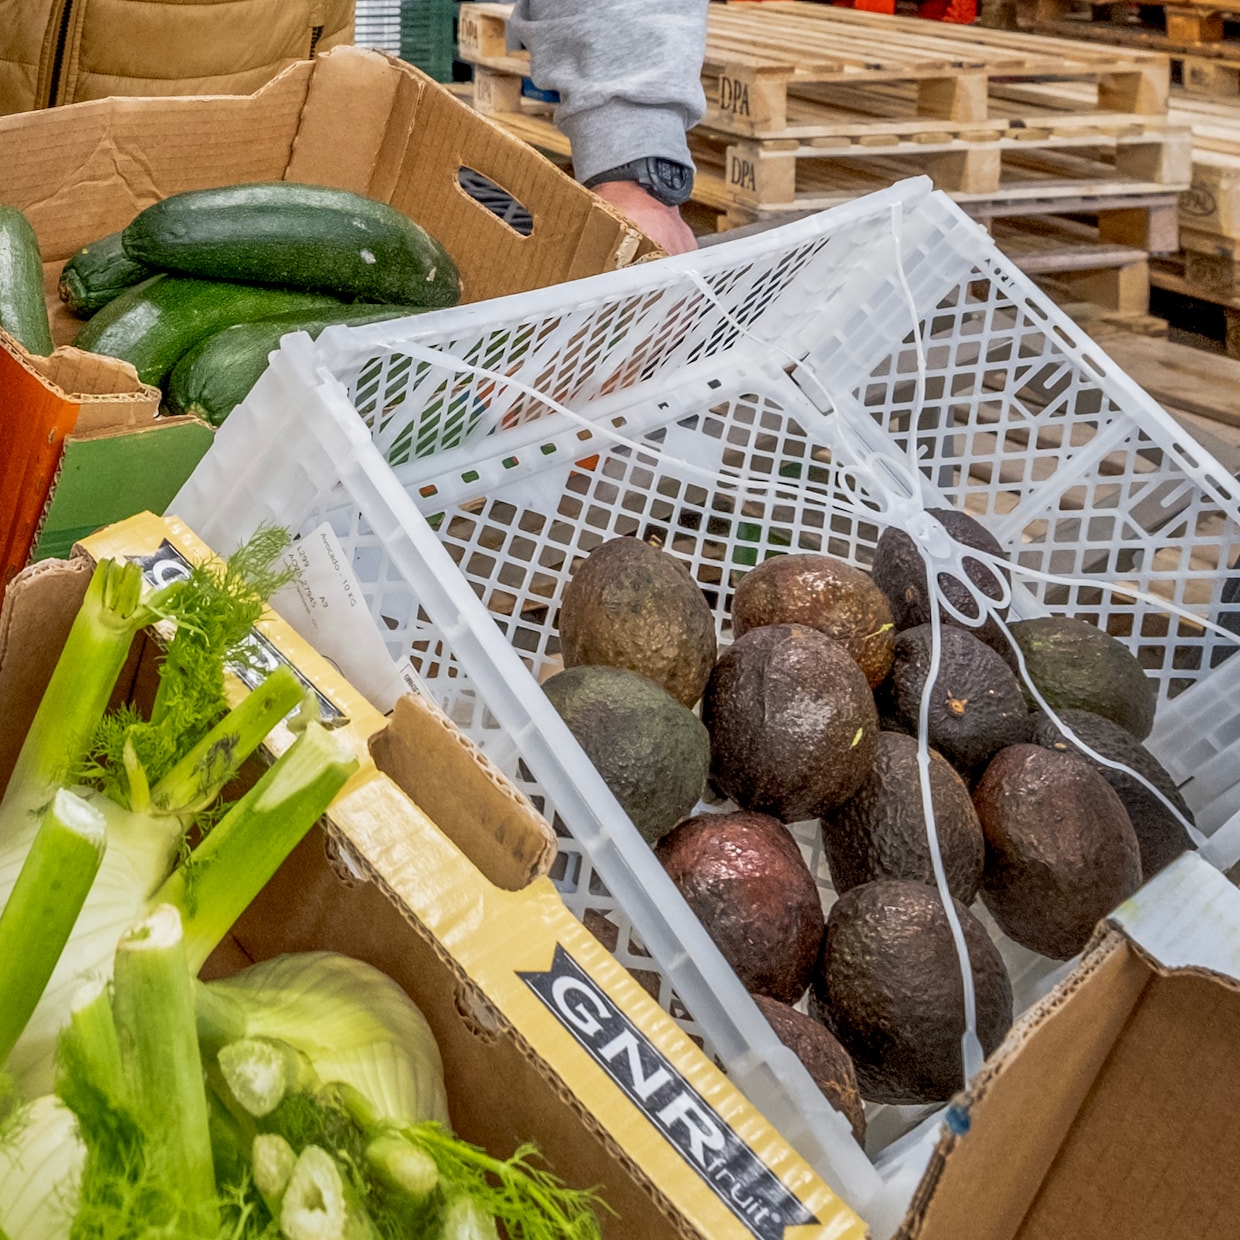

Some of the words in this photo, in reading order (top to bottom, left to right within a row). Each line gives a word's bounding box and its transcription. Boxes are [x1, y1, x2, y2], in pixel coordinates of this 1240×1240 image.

[721, 76, 750, 117] DPA
[731, 156, 756, 192] DPA
[320, 532, 340, 571] Avocado
[342, 578, 351, 592] 10
[347, 592, 357, 608] KG
[319, 595, 329, 609] A9
